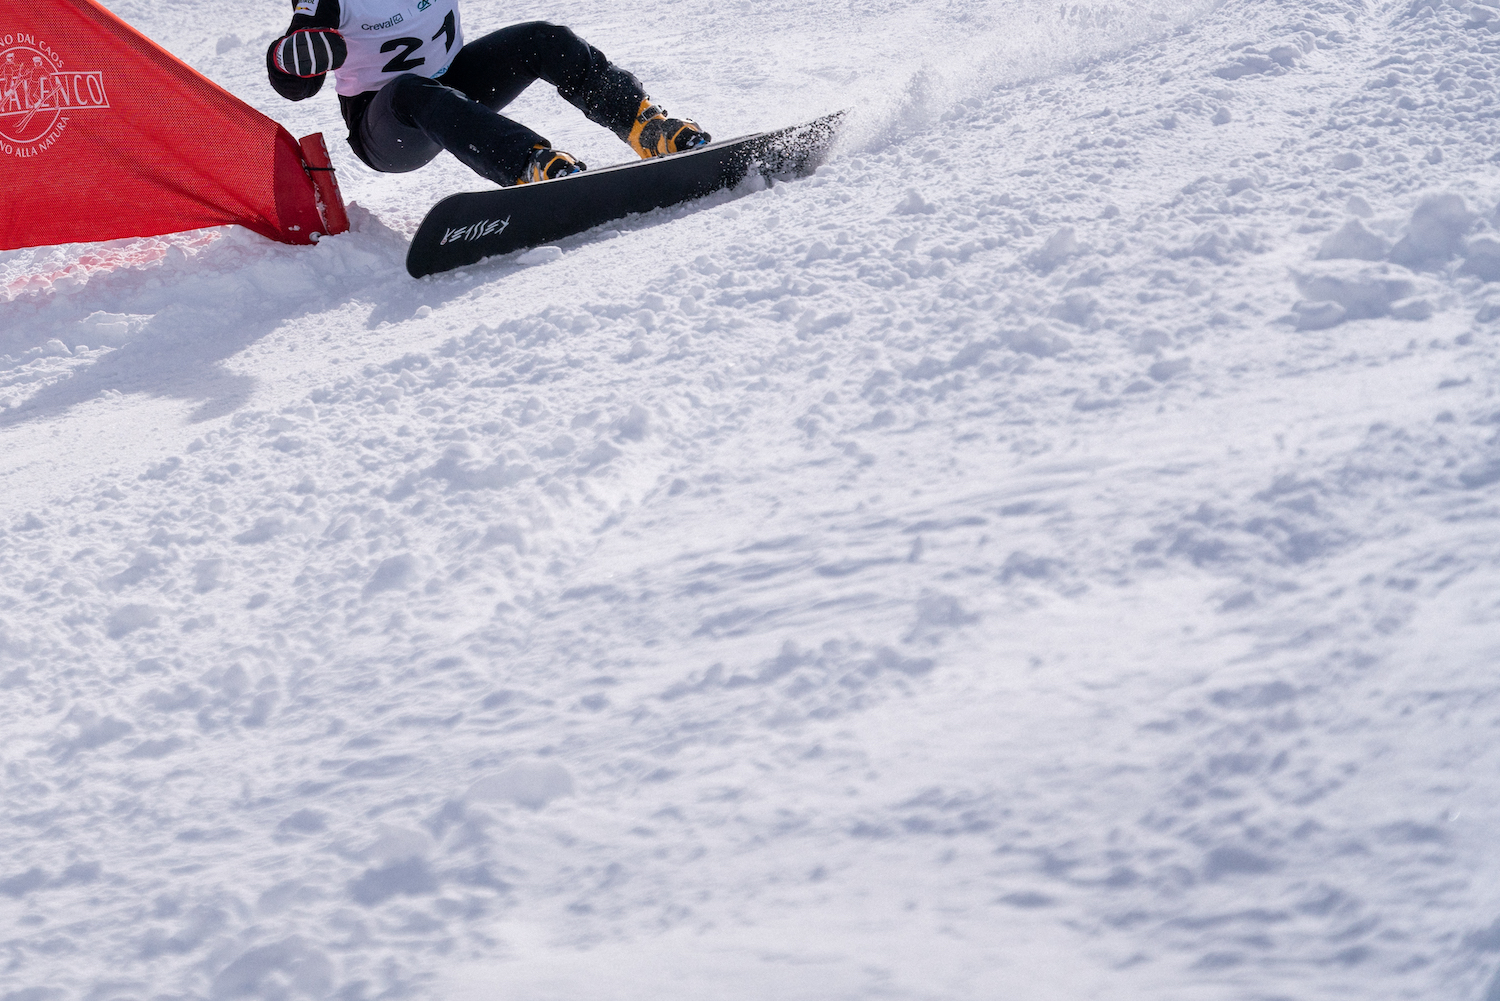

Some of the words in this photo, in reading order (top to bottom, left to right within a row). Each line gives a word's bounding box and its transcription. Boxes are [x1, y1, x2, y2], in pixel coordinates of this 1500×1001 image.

[361, 17, 394, 31] Creval
[380, 9, 455, 73] 21
[17, 33, 36, 46] DAL
[39, 40, 64, 68] CAOS
[15, 146, 38, 157] ALLA
[39, 115, 70, 152] NATURA
